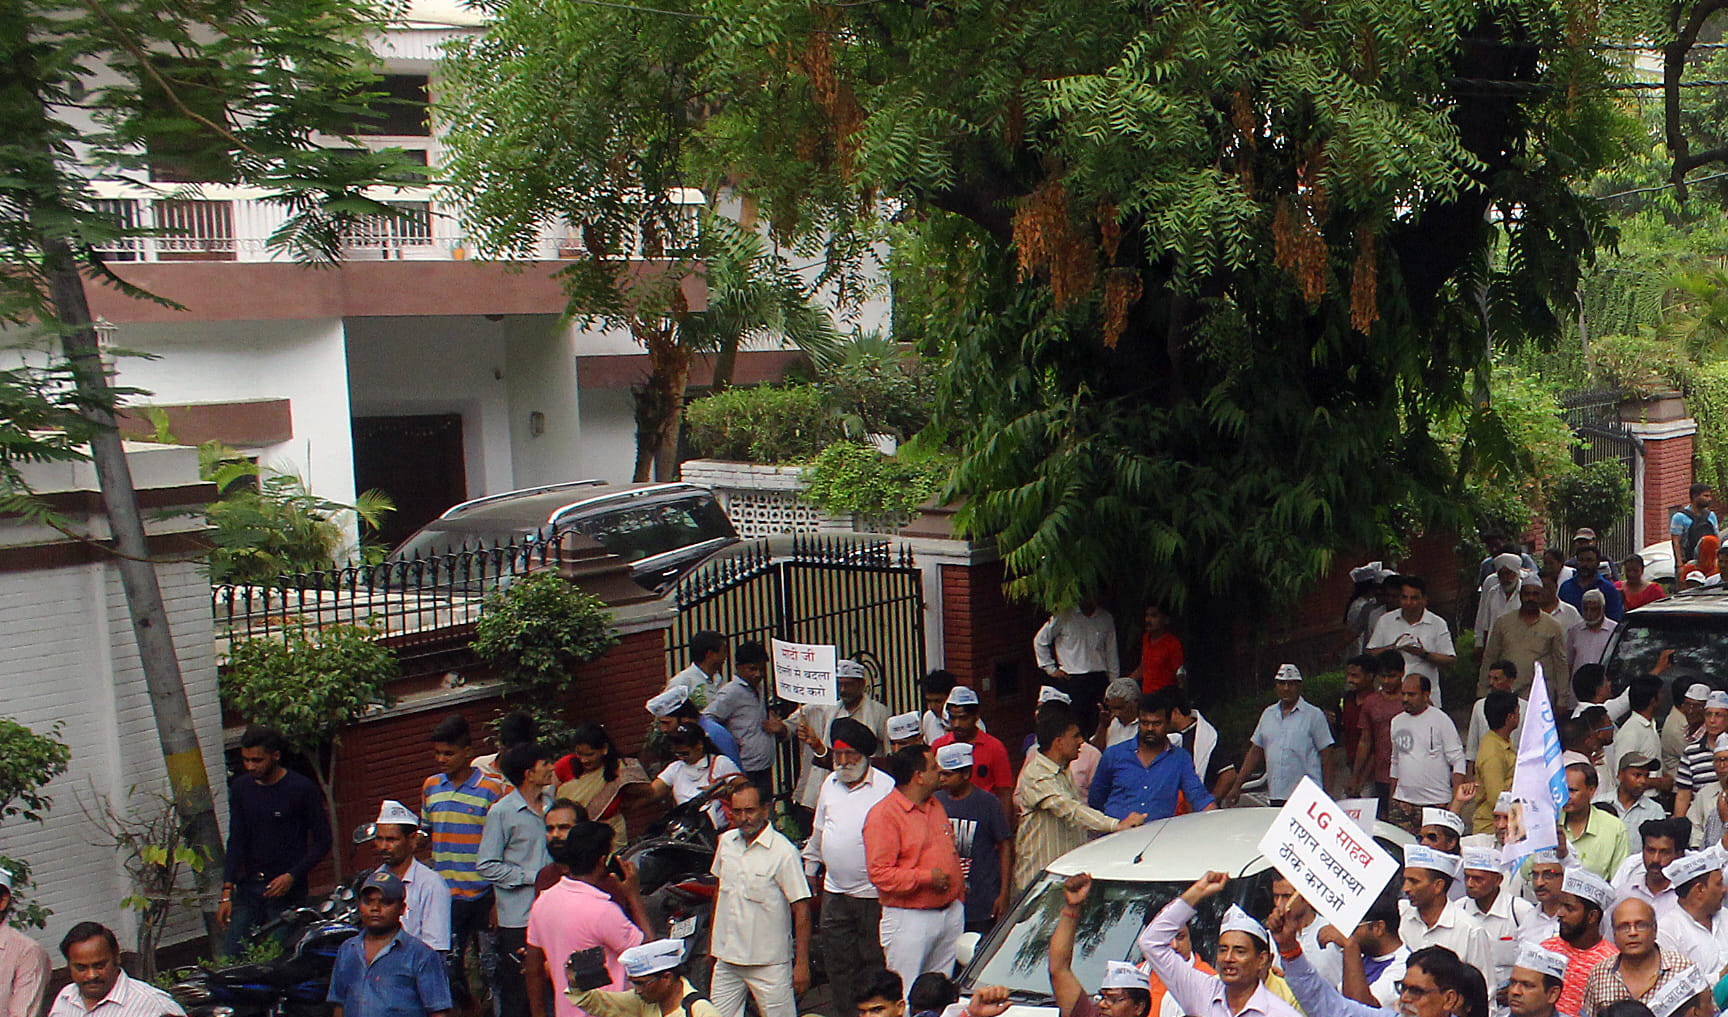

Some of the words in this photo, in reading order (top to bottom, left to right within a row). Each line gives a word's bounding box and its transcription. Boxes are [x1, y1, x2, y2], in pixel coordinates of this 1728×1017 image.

[801, 648, 816, 662] जी
[803, 670, 831, 681] बदला
[1289, 817, 1319, 852] राशन
[1319, 848, 1366, 897] व्यवस्था
[1306, 801, 1332, 830] LG
[1336, 827, 1375, 870] साहब
[1279, 842, 1305, 873] ठीक
[1304, 867, 1345, 912] कराओ
